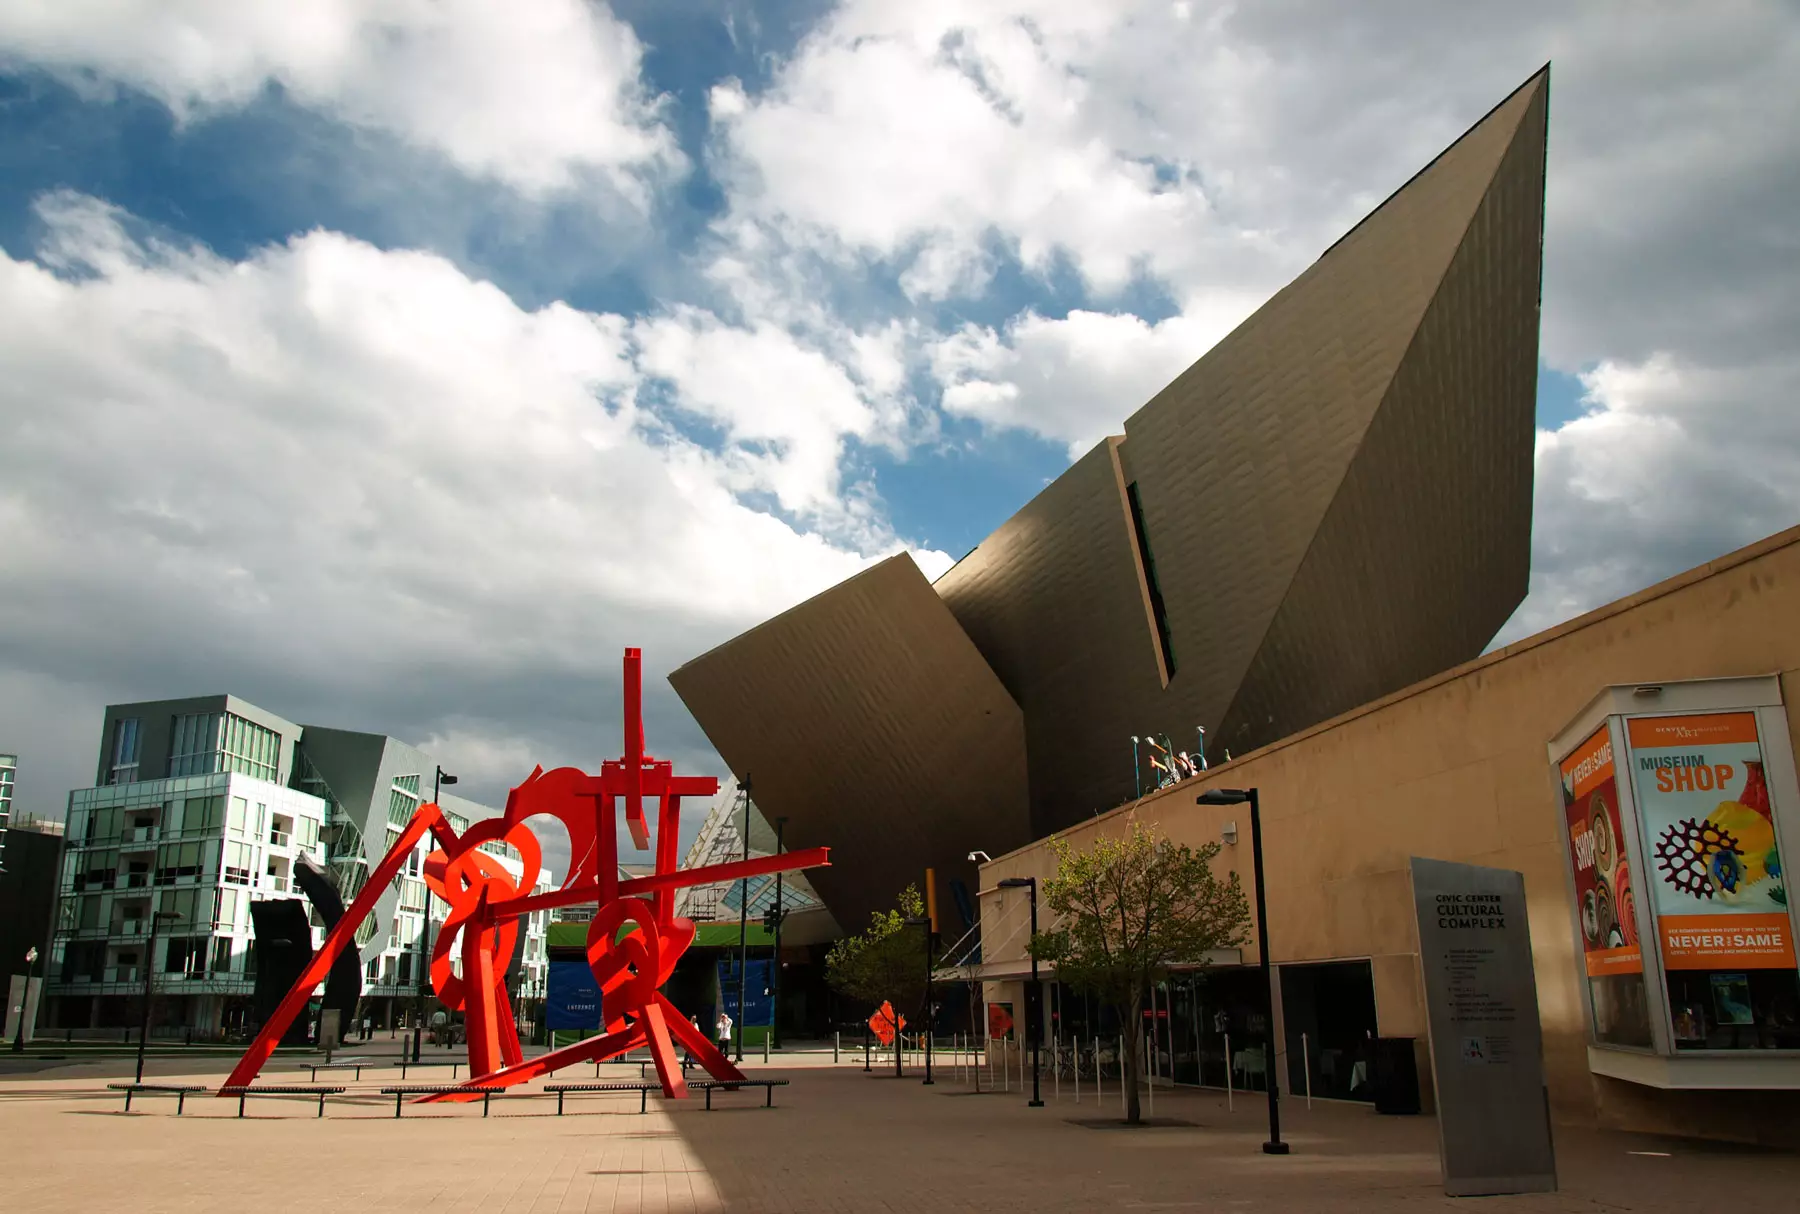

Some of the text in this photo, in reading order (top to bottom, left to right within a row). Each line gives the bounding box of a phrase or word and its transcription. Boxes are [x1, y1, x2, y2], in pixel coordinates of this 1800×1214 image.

[1676, 729, 1698, 738] ART
[1573, 757, 1593, 784] NEVER
[1593, 742, 1613, 771] SAME
[1640, 755, 1705, 770] MUSEUM
[1655, 764, 1734, 793] SHOP
[1575, 829, 1595, 871] SHOP
[1436, 894, 1501, 902] CIVIC CENTER
[1437, 904, 1505, 916] CULTURAL
[1438, 918, 1506, 929] COMPLEX
[1668, 935, 1725, 948] NEVER
[1733, 934, 1784, 947] SAME
